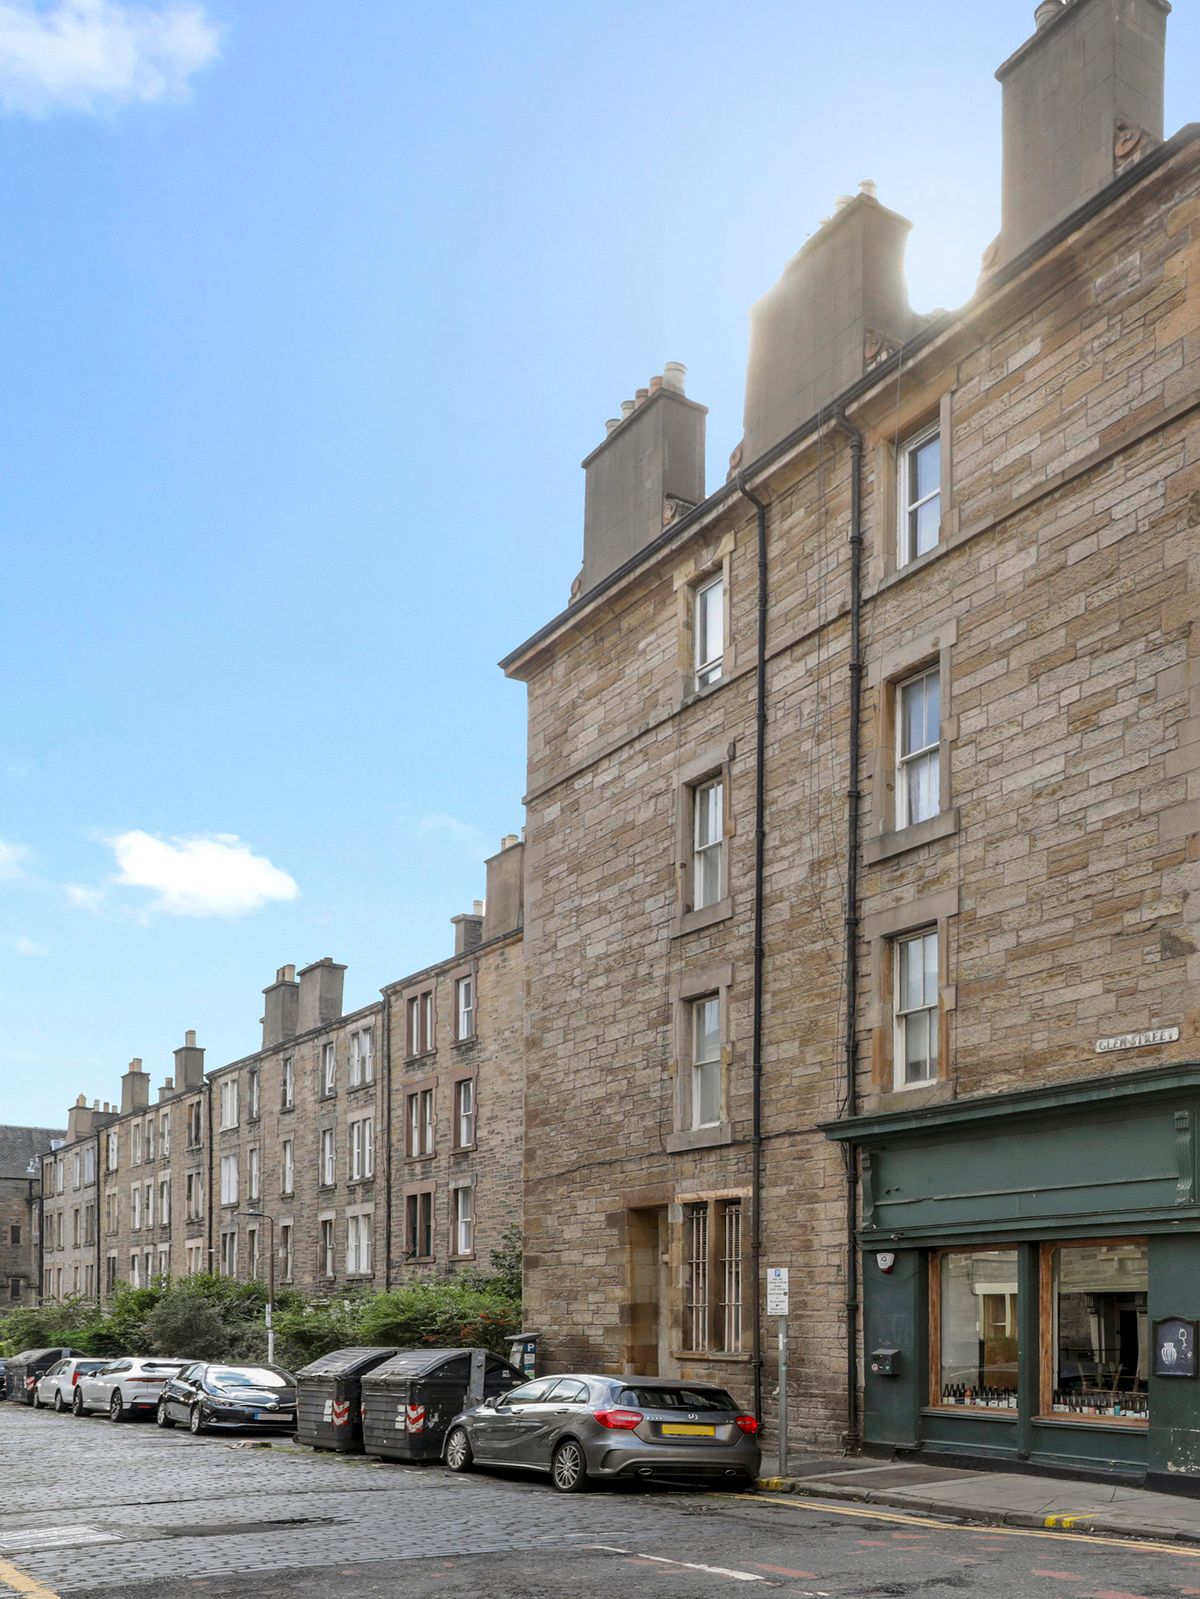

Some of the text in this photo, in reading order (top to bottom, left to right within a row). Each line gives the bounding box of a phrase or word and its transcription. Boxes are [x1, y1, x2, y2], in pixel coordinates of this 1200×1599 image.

[1098, 1030, 1174, 1051] GLEN STREET
[527, 1342, 535, 1352] P
